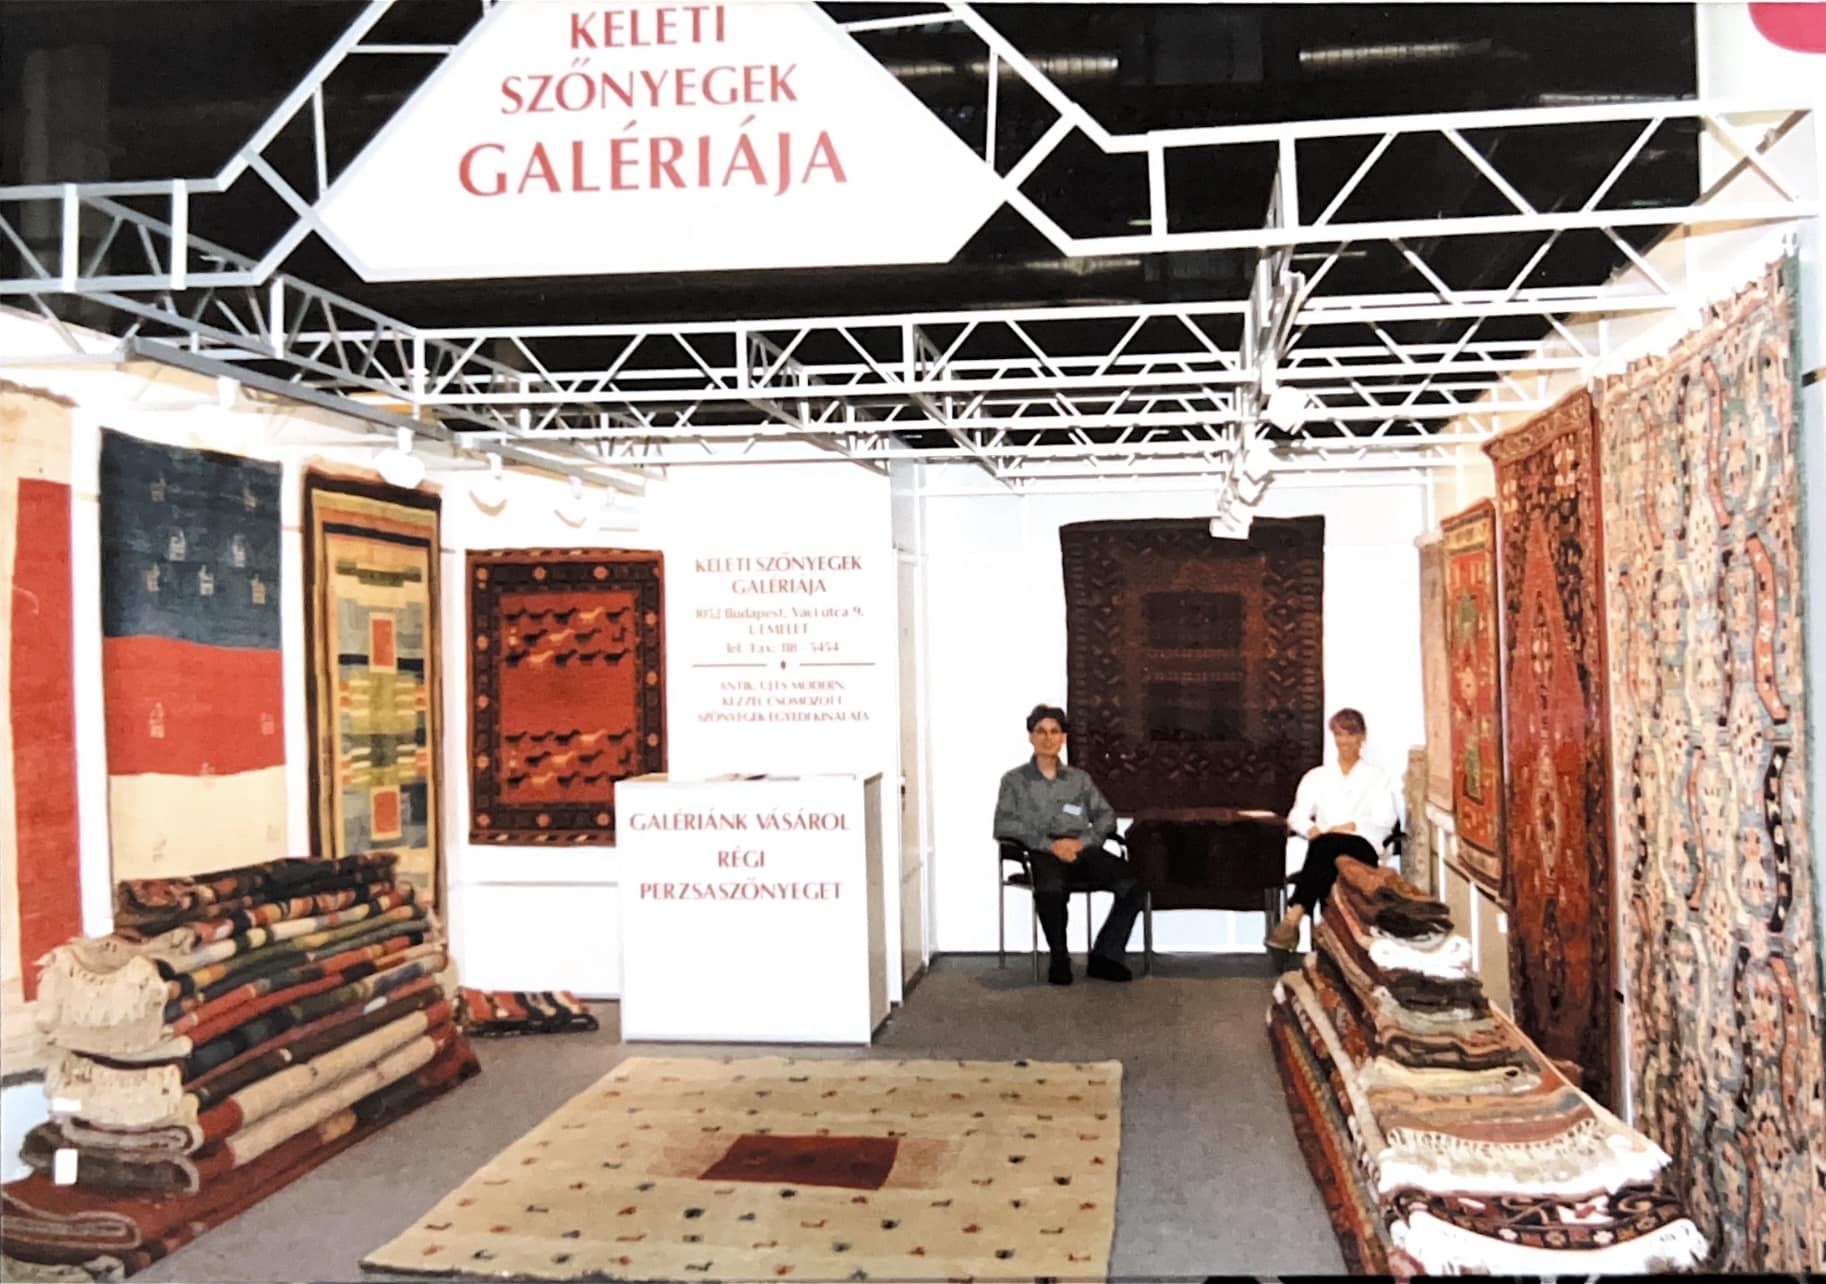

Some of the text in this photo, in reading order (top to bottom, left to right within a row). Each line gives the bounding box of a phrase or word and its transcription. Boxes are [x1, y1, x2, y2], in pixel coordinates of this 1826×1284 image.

[570, 5, 725, 49] KELETI
[501, 57, 798, 115] SZŐNYEGEK
[458, 114, 848, 197] GALÉRIÁJA
[694, 556, 751, 573] KELETI
[821, 606, 849, 618] utca
[629, 808, 849, 831] GALÉRIÁNK VÁSÁROL
[717, 845, 765, 868] RÉGI
[639, 878, 842, 900] PERZSASZŐNYEGET
